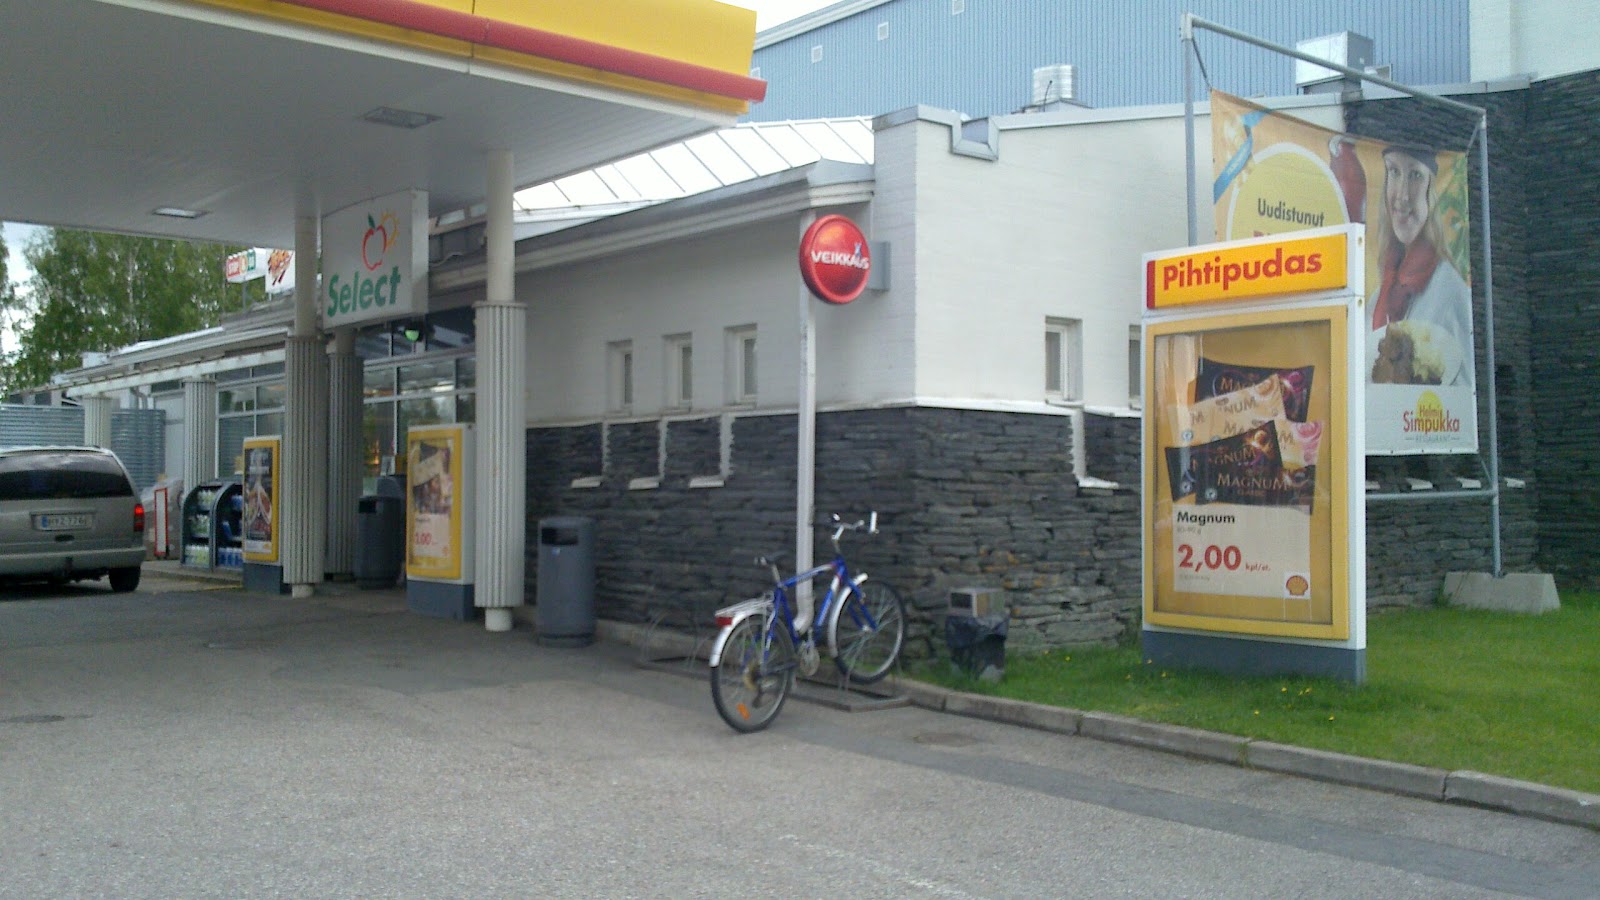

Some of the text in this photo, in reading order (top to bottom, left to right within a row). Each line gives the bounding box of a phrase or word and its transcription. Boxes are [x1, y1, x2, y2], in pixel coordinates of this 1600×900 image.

[1257, 197, 1325, 228] Uudistunut
[1163, 248, 1323, 291] Pihtipudas
[327, 266, 401, 318] Select
[1403, 410, 1460, 434] Simpukka
[1217, 473, 1289, 491] MAGNUM
[1177, 511, 1236, 527] Magnum
[1177, 544, 1242, 573] 2,00
